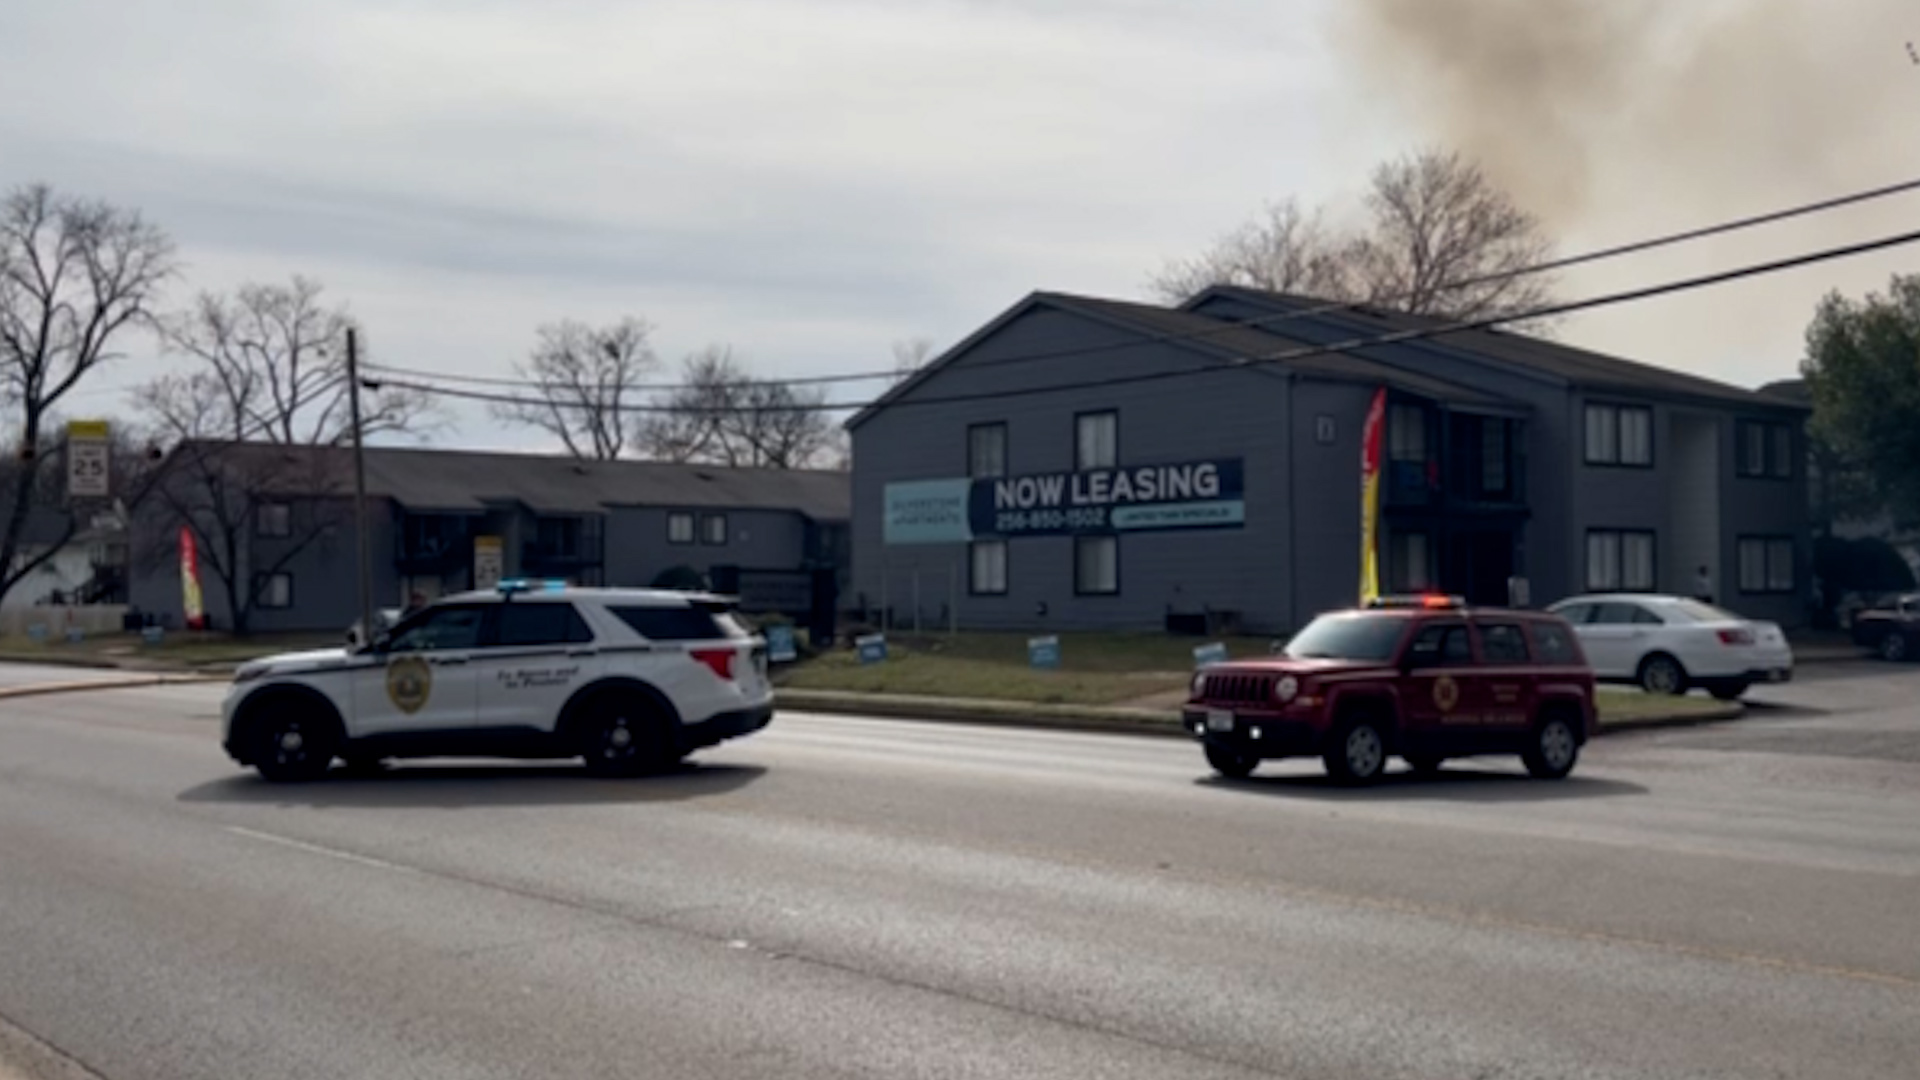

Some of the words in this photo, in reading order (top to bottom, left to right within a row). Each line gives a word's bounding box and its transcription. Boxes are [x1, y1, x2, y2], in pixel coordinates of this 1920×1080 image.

[74, 458, 104, 476] 25
[995, 474, 1065, 509] NOW
[1071, 463, 1219, 504] LEASING
